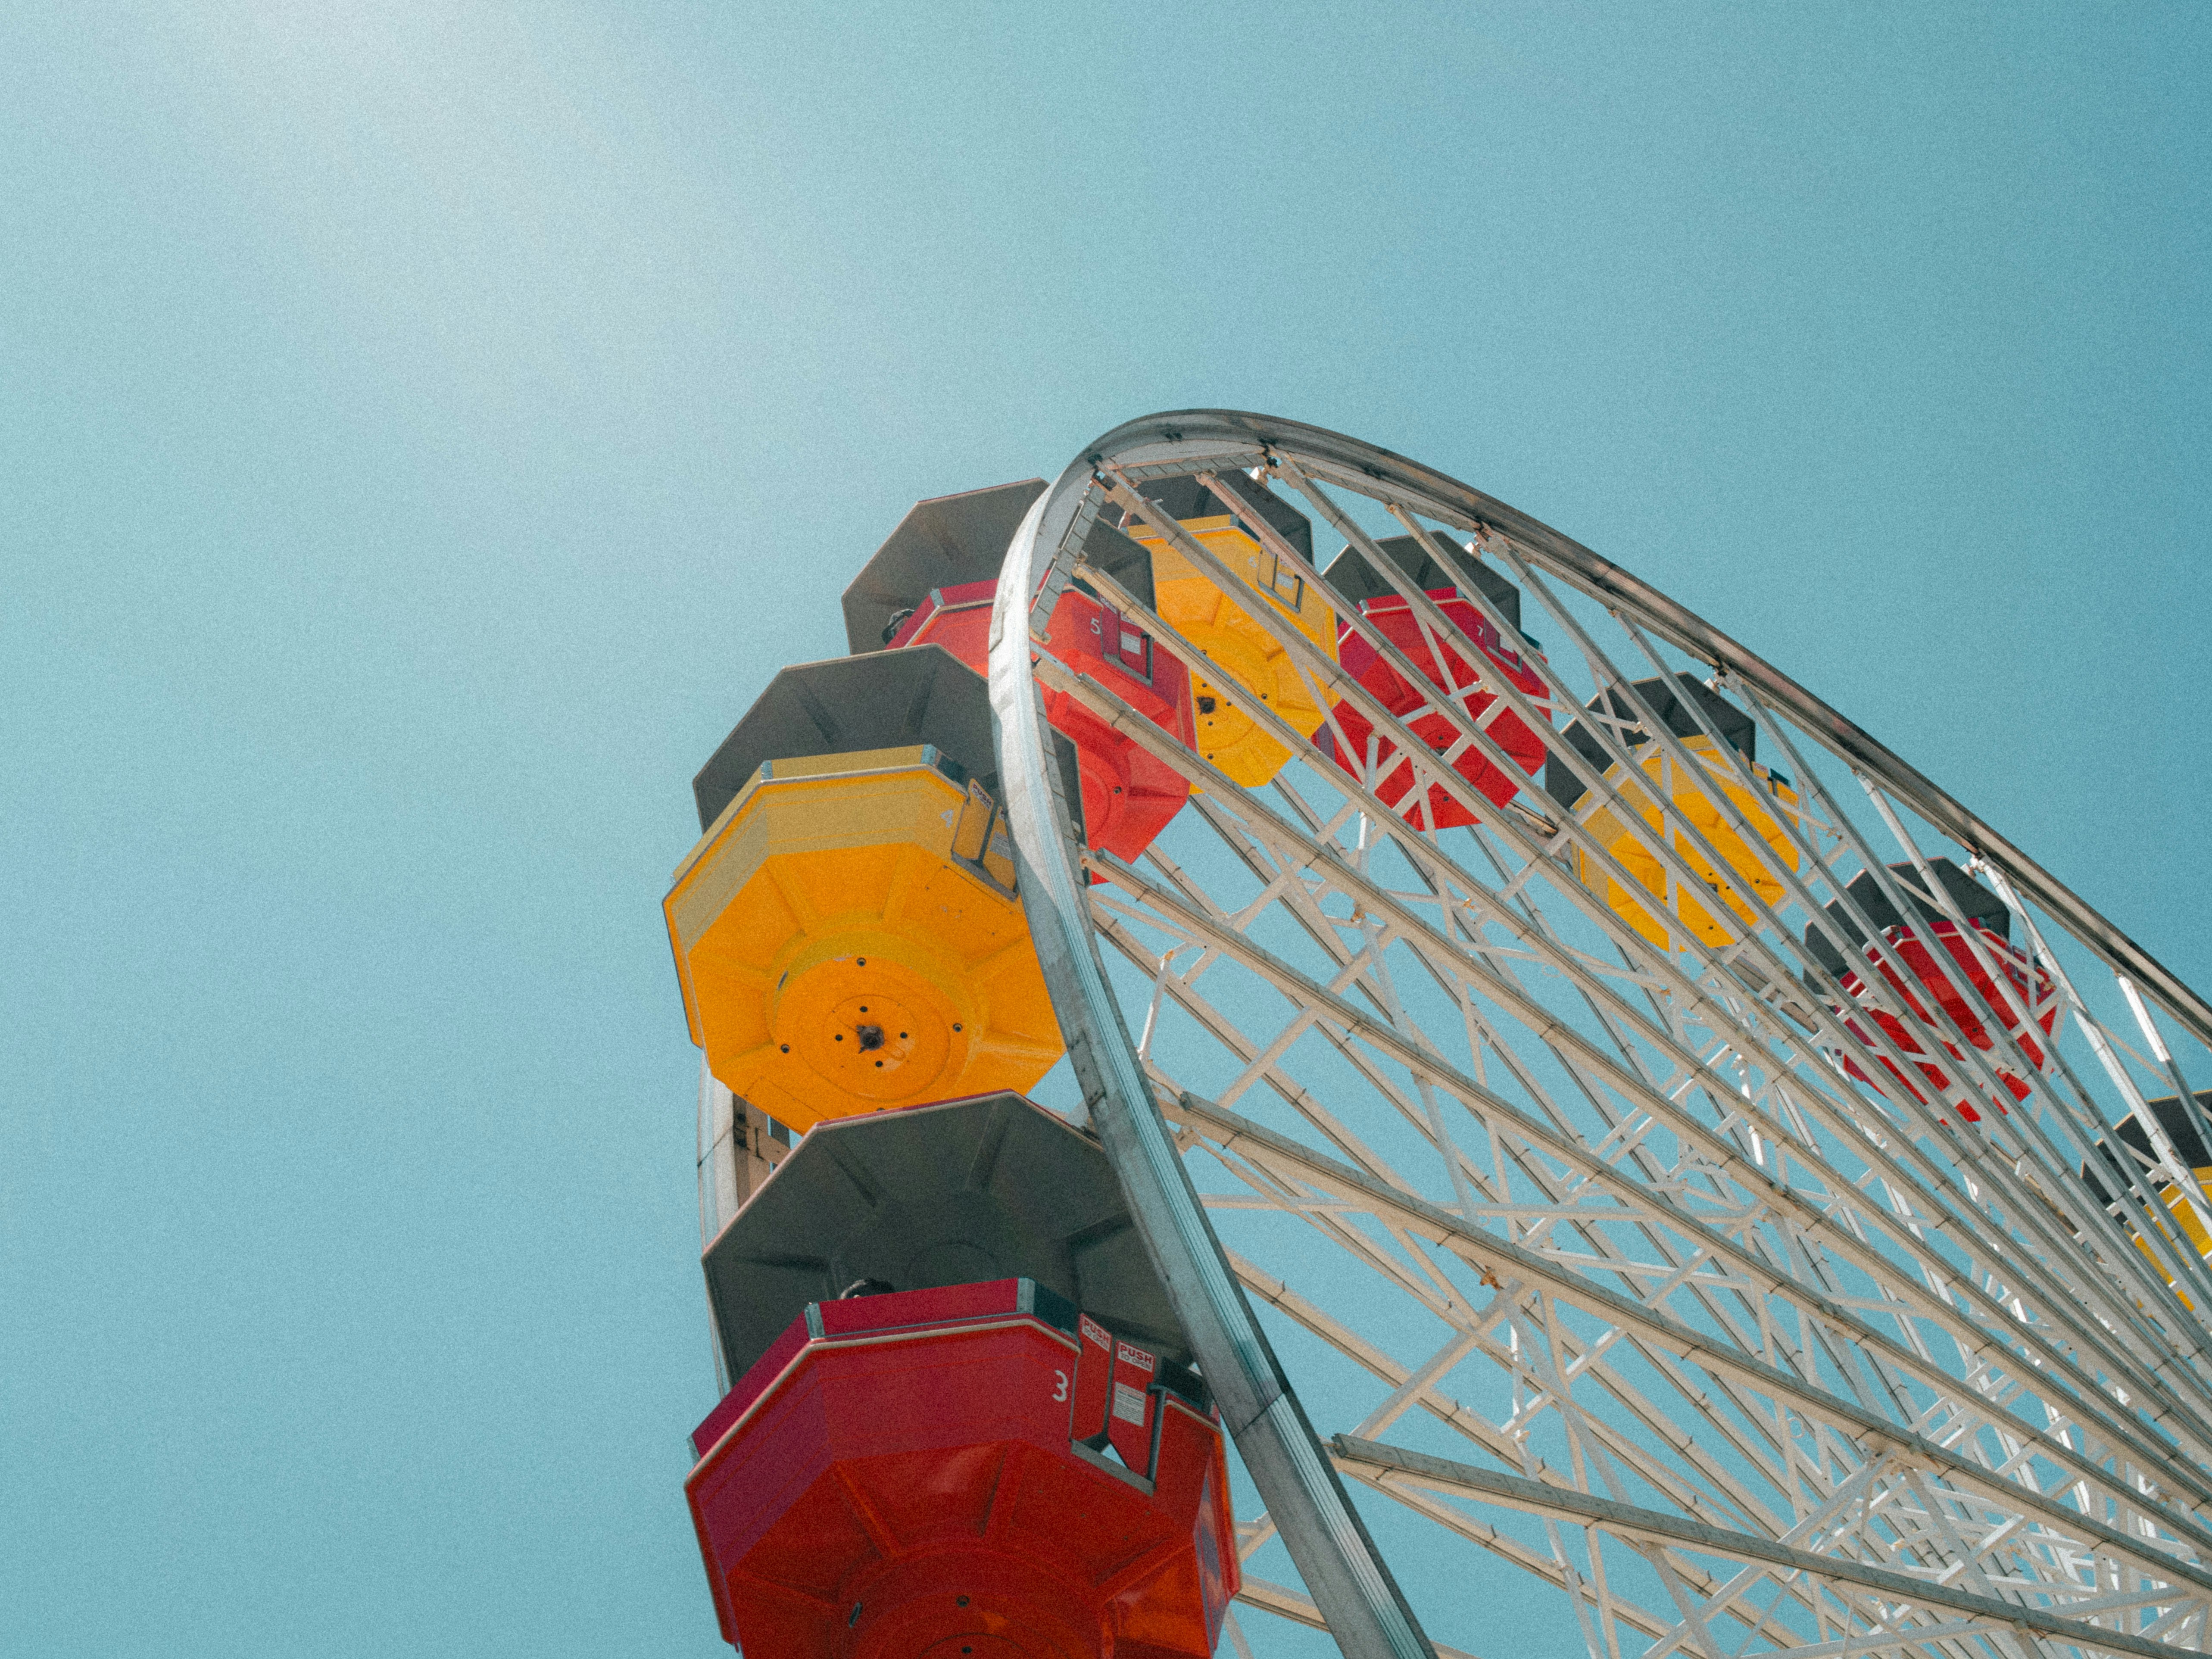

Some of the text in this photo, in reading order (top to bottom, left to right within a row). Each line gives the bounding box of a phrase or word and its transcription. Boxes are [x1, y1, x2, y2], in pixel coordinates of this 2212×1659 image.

[1248, 556, 1257, 568] 6
[1091, 617, 1100, 634] 5
[1477, 625, 1483, 636] 7
[973, 784, 991, 805] PUSH
[940, 809, 953, 828] 4
[1084, 1319, 1109, 1343] PUSH
[1120, 1345, 1151, 1364] PUSH
[1132, 1358, 1150, 1369] OPEN
[1052, 1370, 1068, 1402] 3
